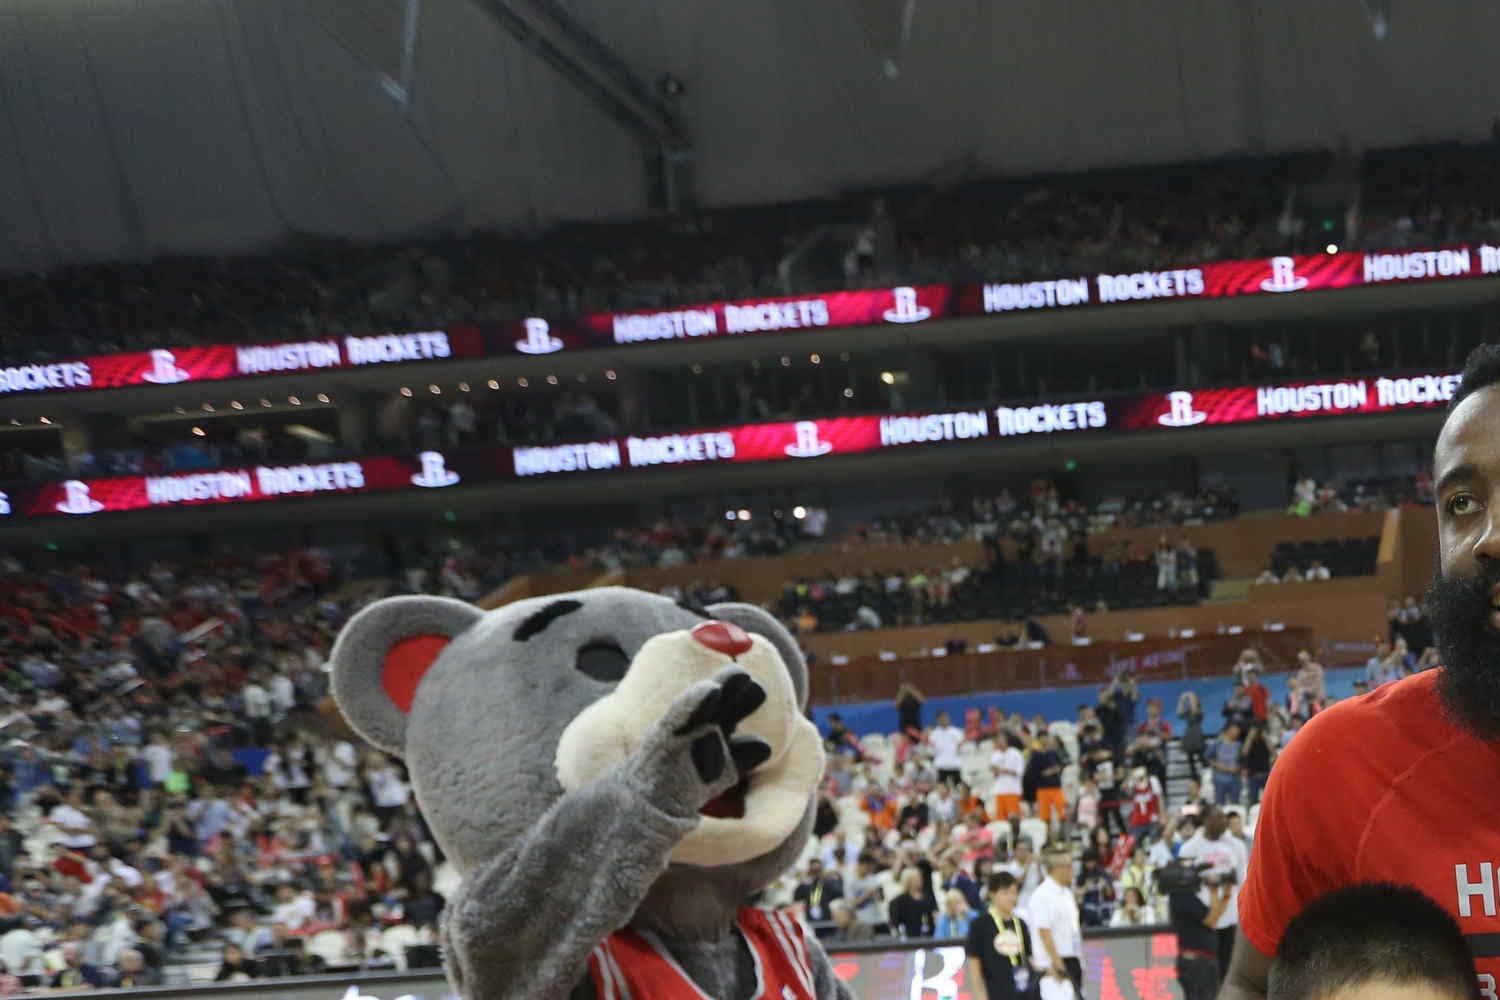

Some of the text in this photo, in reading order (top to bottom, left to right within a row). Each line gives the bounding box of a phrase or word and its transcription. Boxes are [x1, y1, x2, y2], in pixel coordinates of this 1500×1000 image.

[1363, 248, 1470, 282] HOUSTON
[983, 269, 1204, 313] HOUSTON ROCKETS
[612, 299, 829, 344] HOUSTON ROCKETS
[237, 331, 450, 374] HOUSTON ROCKETS
[1257, 381, 1366, 415] HOUSTON
[880, 401, 1107, 446] HOUSTON ROCKETS
[513, 432, 736, 476] HOUSTON ROCKETS
[256, 461, 365, 496] ROCKETS
